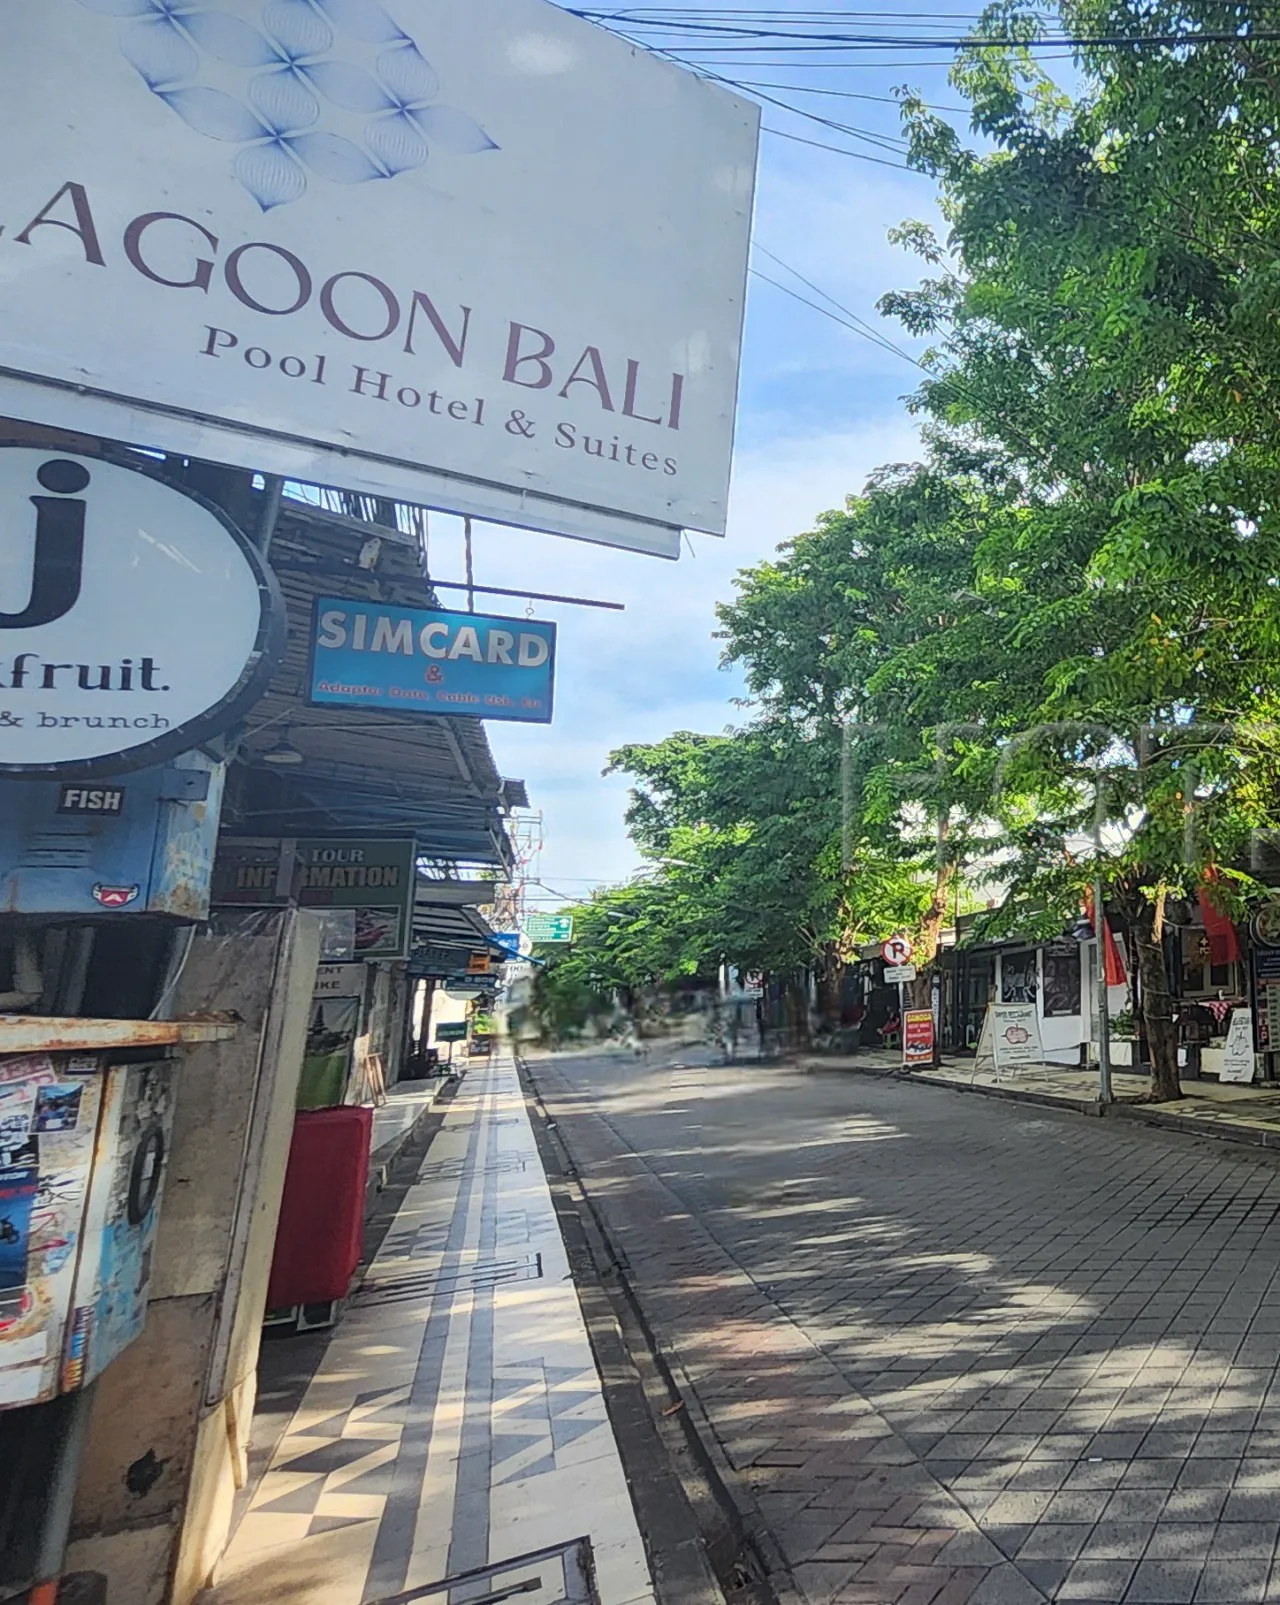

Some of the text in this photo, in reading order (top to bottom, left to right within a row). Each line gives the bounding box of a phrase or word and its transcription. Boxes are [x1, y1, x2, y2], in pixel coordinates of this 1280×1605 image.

[0, 180, 684, 431] AGOON BALI
[199, 324, 679, 477] Pool Hotel & Suites
[317, 610, 550, 667] SIMCARD
[425, 663, 443, 684] &
[36, 711, 170, 729] brunch
[63, 789, 121, 811] FISH
[311, 847, 365, 863] TOUR
[236, 864, 399, 890] INFMATION
[316, 965, 344, 976] ENT
[314, 980, 341, 991] IKE
